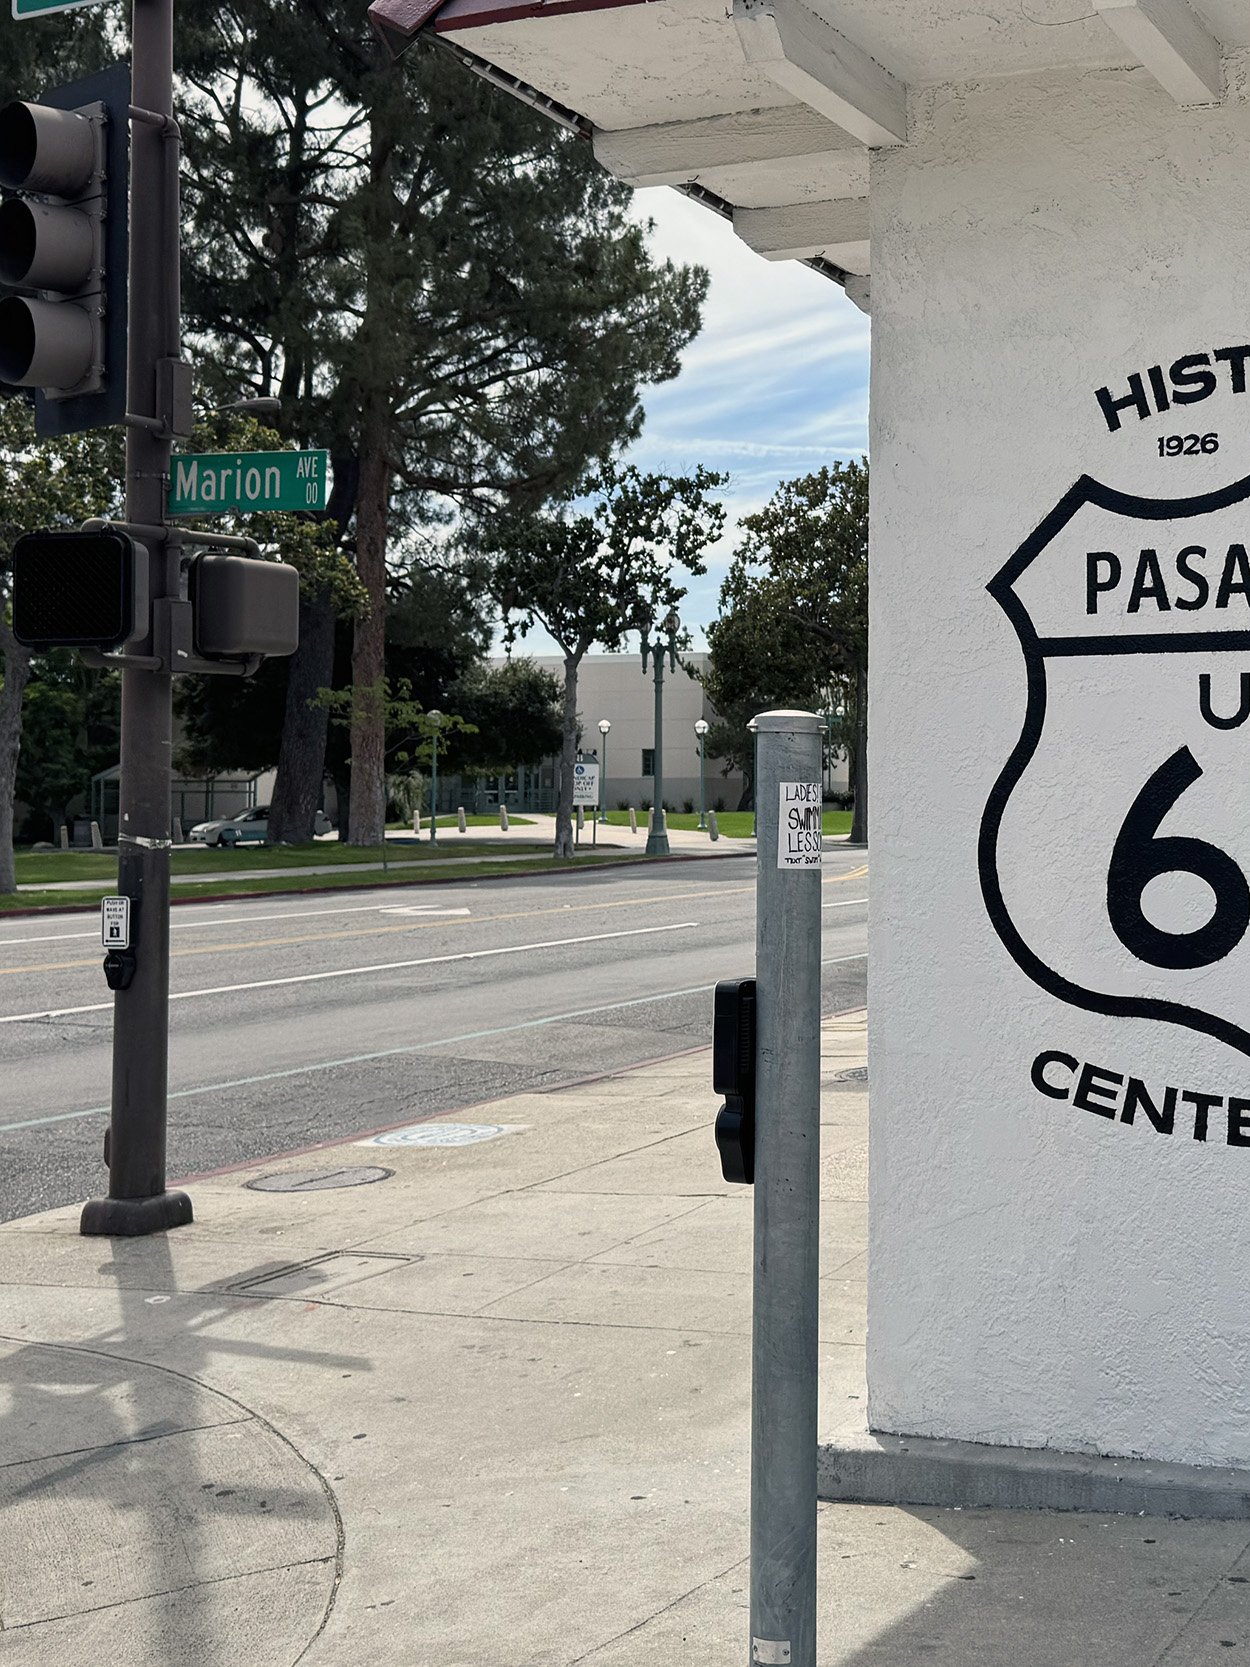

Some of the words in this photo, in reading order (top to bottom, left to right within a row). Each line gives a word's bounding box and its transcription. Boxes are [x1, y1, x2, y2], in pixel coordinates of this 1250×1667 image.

[1157, 433, 1220, 458] 1926
[176, 459, 281, 501] Marion
[296, 456, 318, 478] AVE
[306, 482, 318, 504] 00
